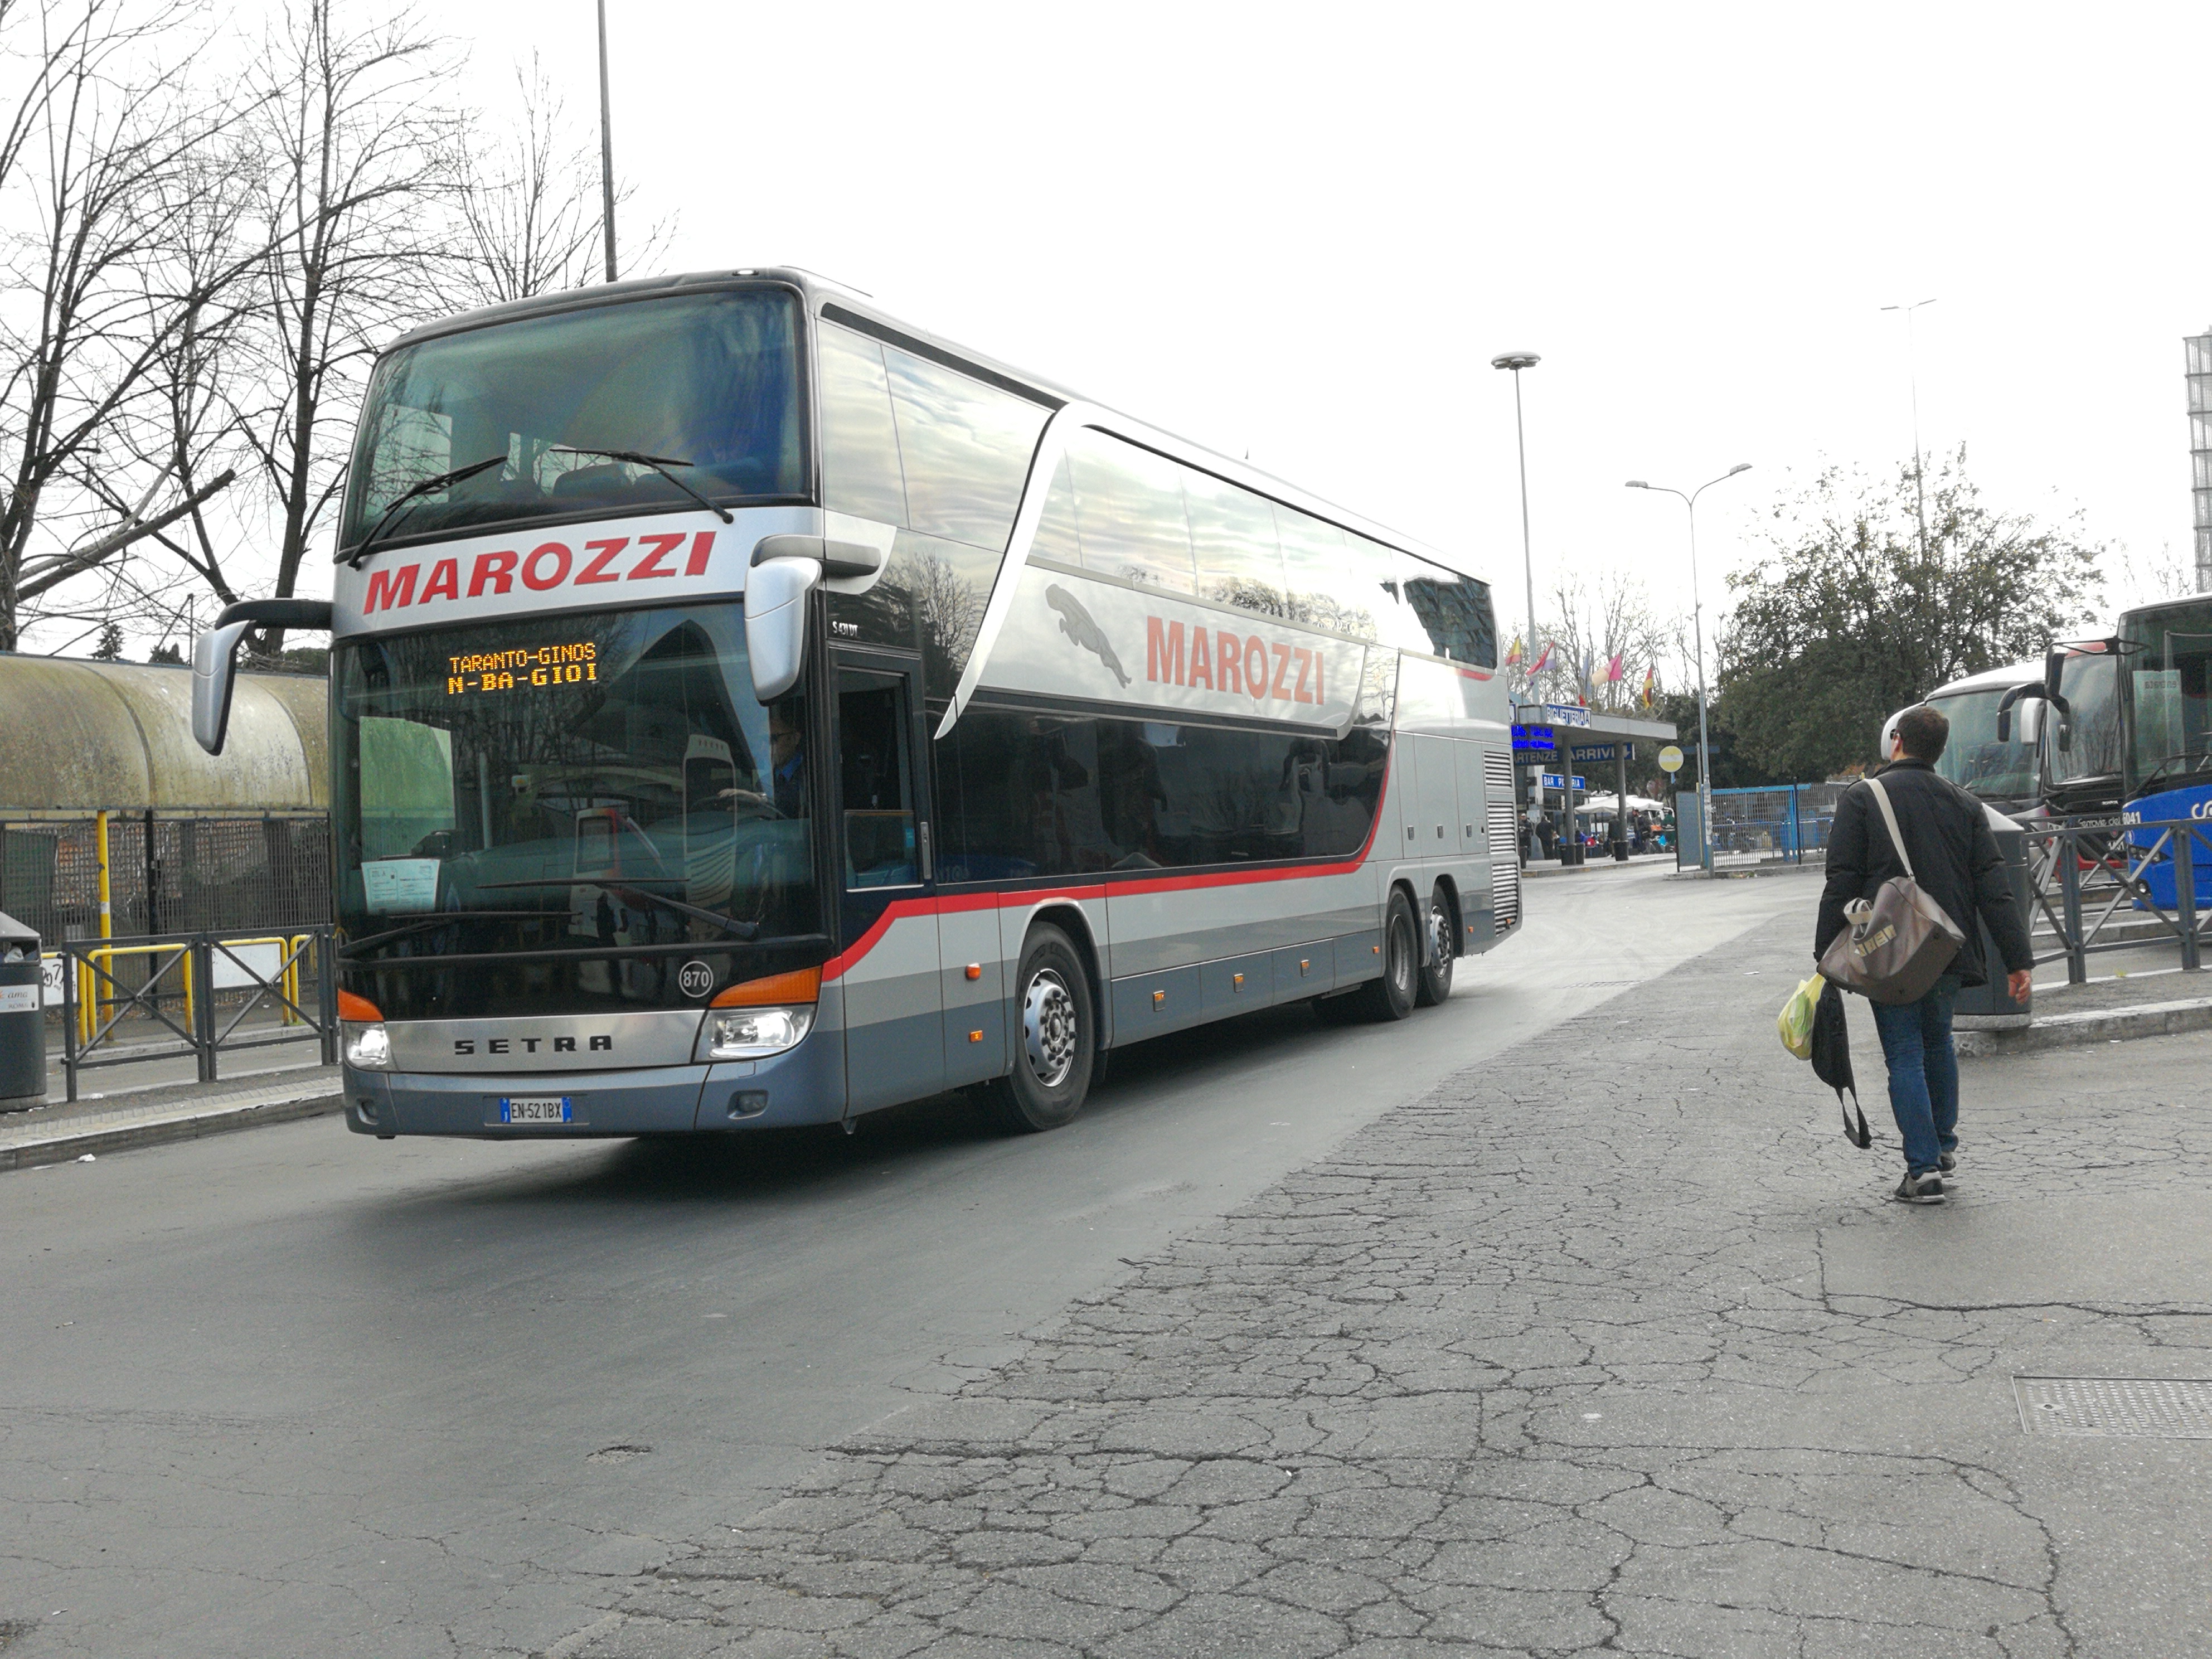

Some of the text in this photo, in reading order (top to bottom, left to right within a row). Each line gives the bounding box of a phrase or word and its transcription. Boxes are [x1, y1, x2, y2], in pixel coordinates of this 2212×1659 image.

[363, 531, 717, 614] MAROZZI
[1147, 615, 1325, 706] MAROZZI
[1544, 777, 1554, 786] BAR
[2122, 812, 2141, 825] 6041
[683, 971, 710, 987] 870
[454, 1035, 612, 1055] SETRA
